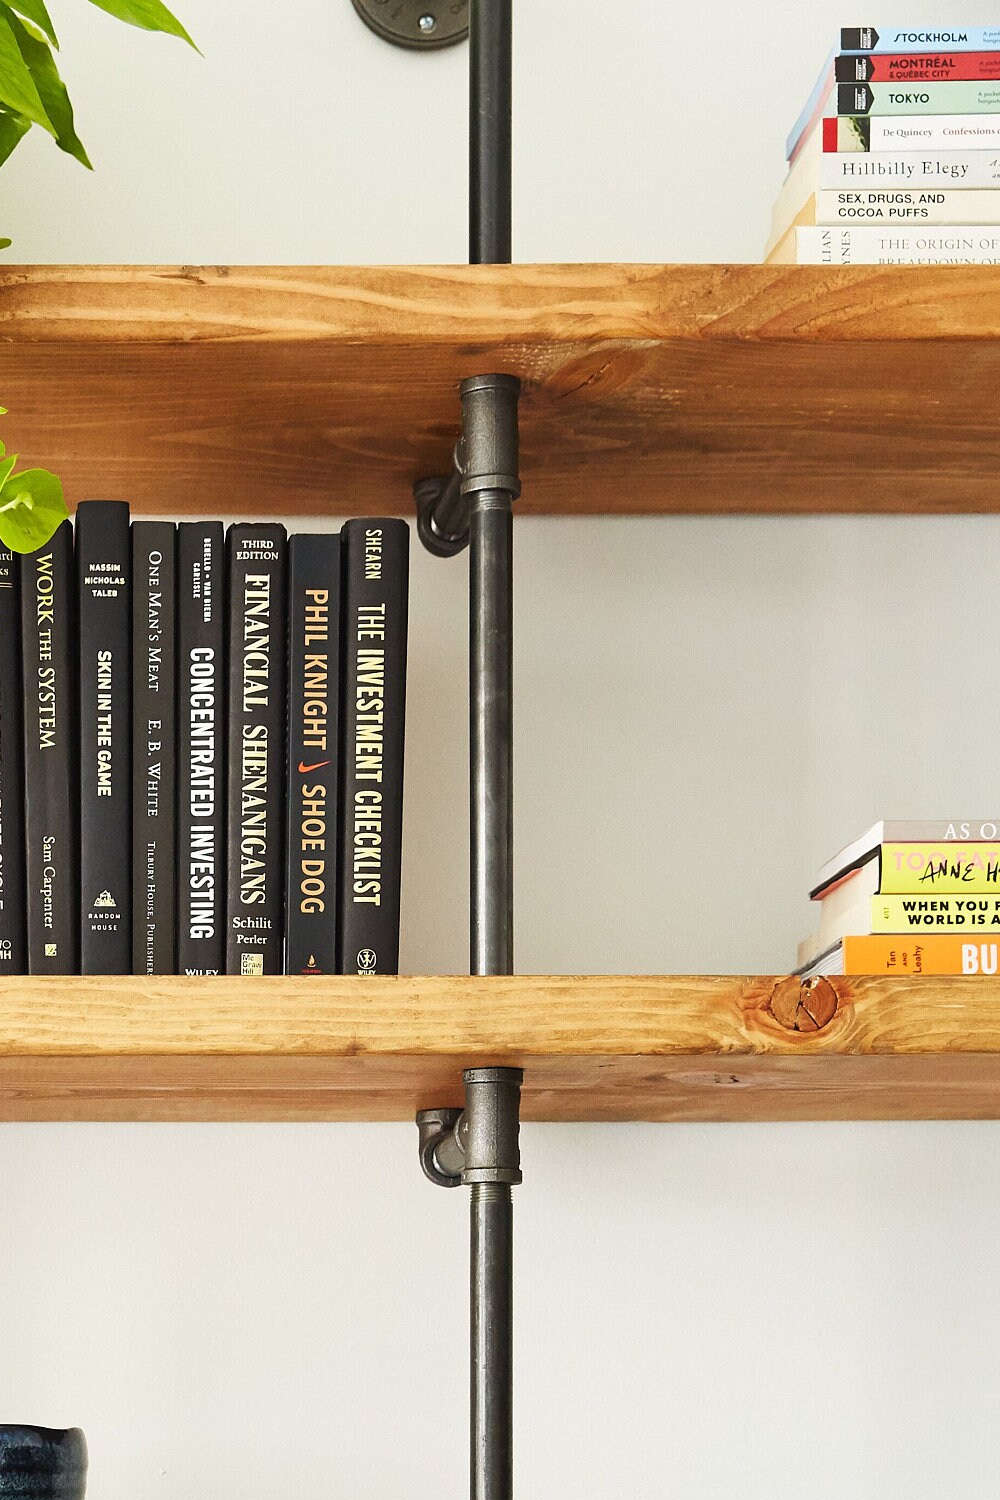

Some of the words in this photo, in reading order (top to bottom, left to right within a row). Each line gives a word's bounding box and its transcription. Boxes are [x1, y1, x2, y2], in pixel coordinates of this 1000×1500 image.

[894, 33, 967, 42] STOCKHOLM
[889, 57, 956, 69] MONTRÉAL
[889, 94, 929, 103] TOKYO
[843, 162, 914, 178] Hillbilly
[922, 162, 968, 177] Elegy
[838, 194, 864, 204] SEX,
[869, 194, 914, 204] DRUGS,
[919, 194, 944, 203] AND
[839, 208, 883, 217] COCOA
[889, 209, 928, 217] PUFFS
[149, 551, 162, 586] ONE
[365, 530, 382, 579] SHEARN
[37, 553, 53, 625] WORK
[149, 592, 162, 641] MAN'S
[305, 590, 328, 645] PHIL
[358, 603, 385, 641] THE
[39, 629, 51, 660] THE
[243, 574, 270, 711] FINANCIAL
[98, 651, 111, 689] SKIN
[149, 648, 161, 691] MEAT
[38, 668, 55, 750] SYSTEM
[98, 694, 111, 710] IN
[304, 655, 327, 750] KNIGHT
[355, 650, 384, 782] INVESTMENT
[98, 714, 111, 746] THE
[190, 648, 214, 816] CONCENTRATED
[98, 750, 111, 796] GAME
[240, 725, 268, 904] SHENANIGANS
[302, 784, 326, 850] SHOE
[43, 836, 55, 862] Sam
[353, 791, 382, 906] CHECKLIST
[43, 867, 55, 928] Carpenter
[190, 826, 214, 938] INVESTING
[301, 860, 325, 913] DOG
[903, 902, 948, 911] WHEN
[956, 901, 988, 911] YOU
[908, 915, 965, 924] WORLD
[972, 915, 985, 924] IS
